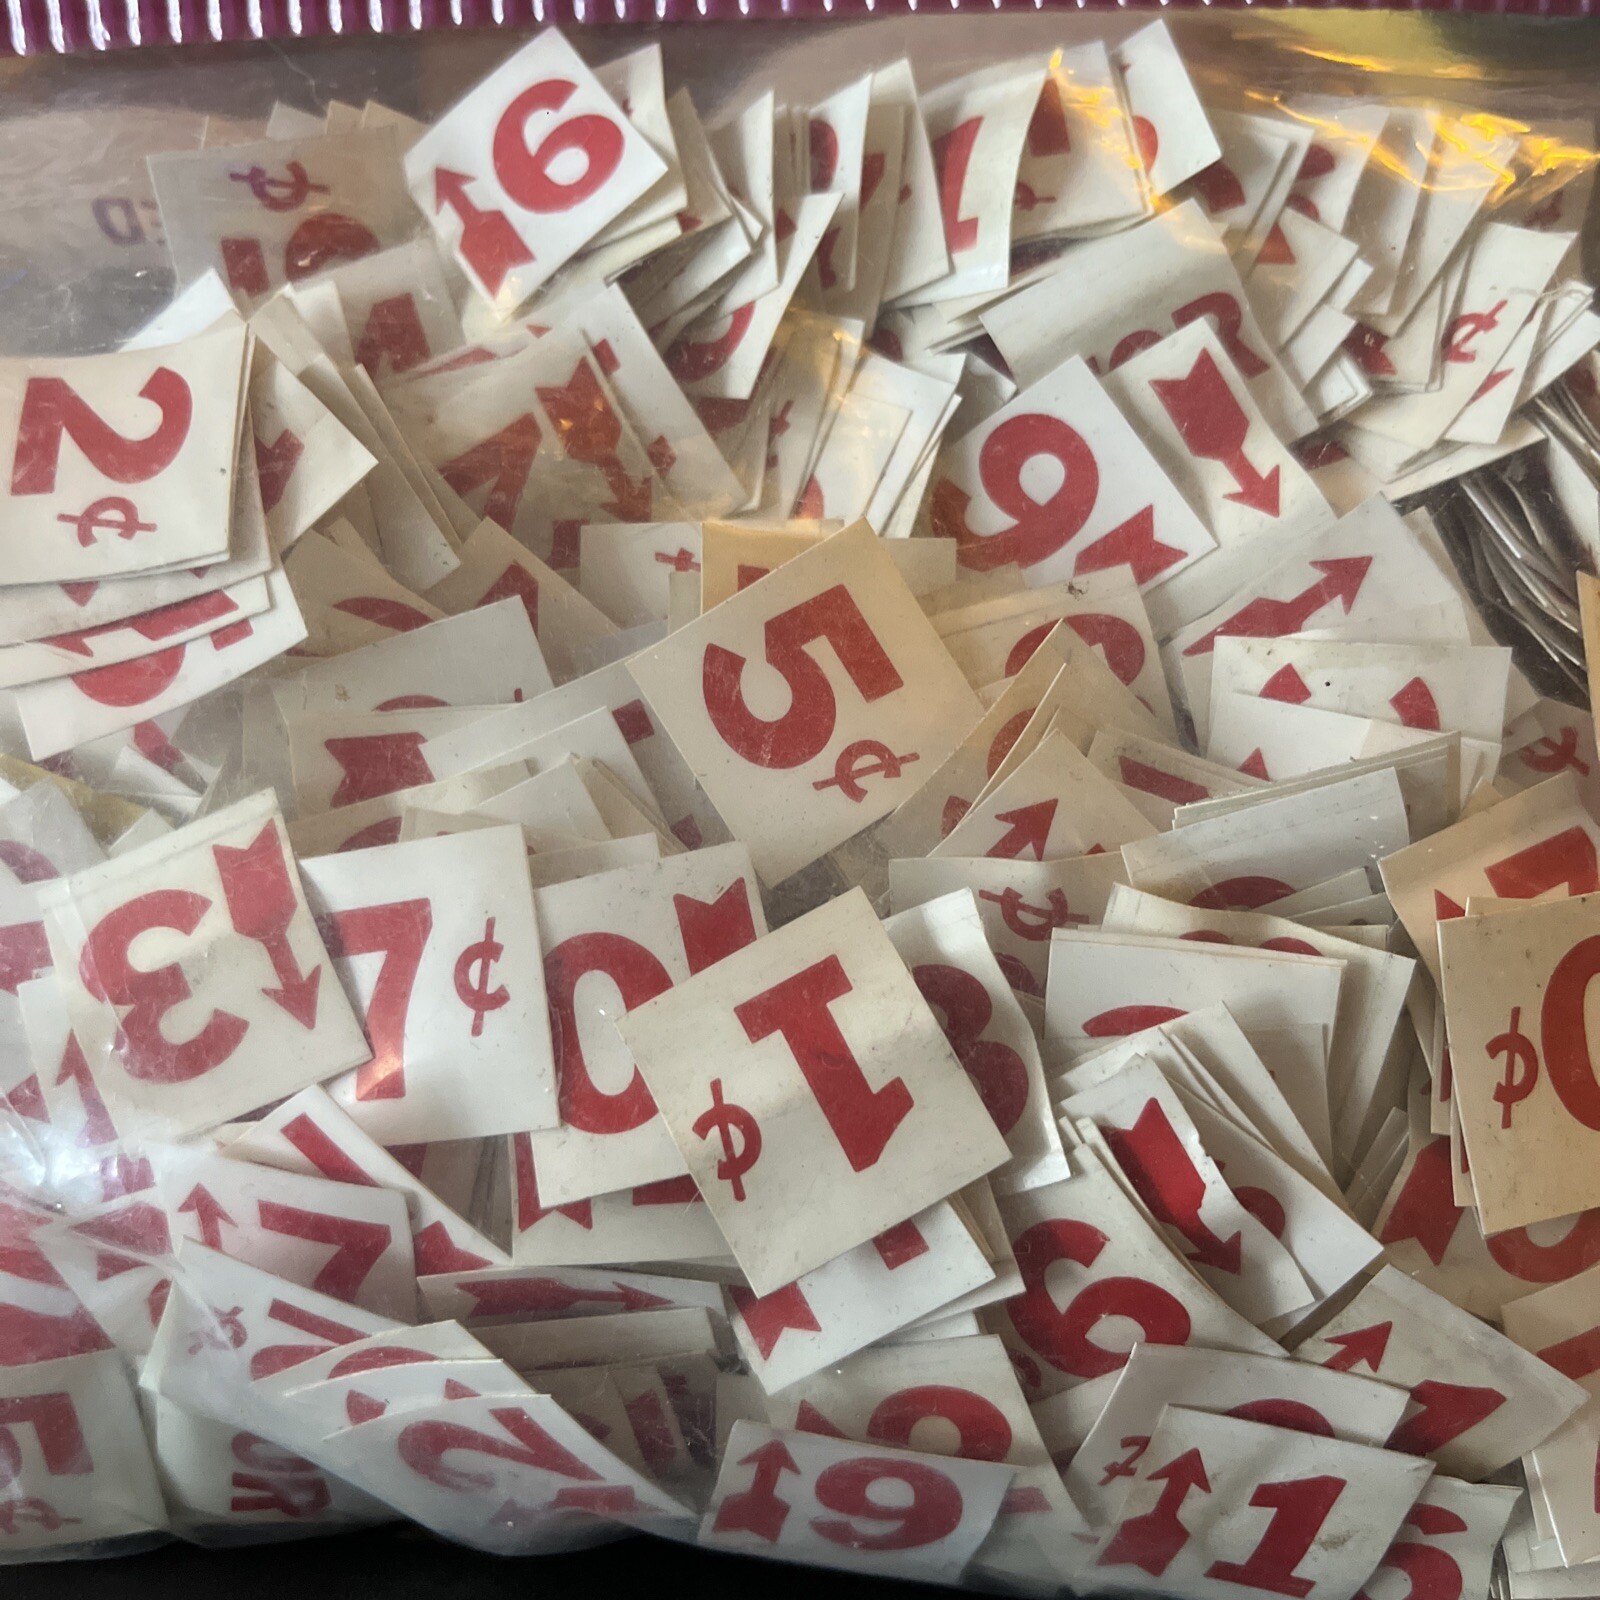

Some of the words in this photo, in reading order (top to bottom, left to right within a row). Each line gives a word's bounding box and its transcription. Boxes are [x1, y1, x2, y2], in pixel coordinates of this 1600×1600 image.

[493, 79, 625, 213] 6
[79, 889, 250, 1084] 3
[809, 1456, 963, 1551] 9
[1204, 1474, 1348, 1598] 1
